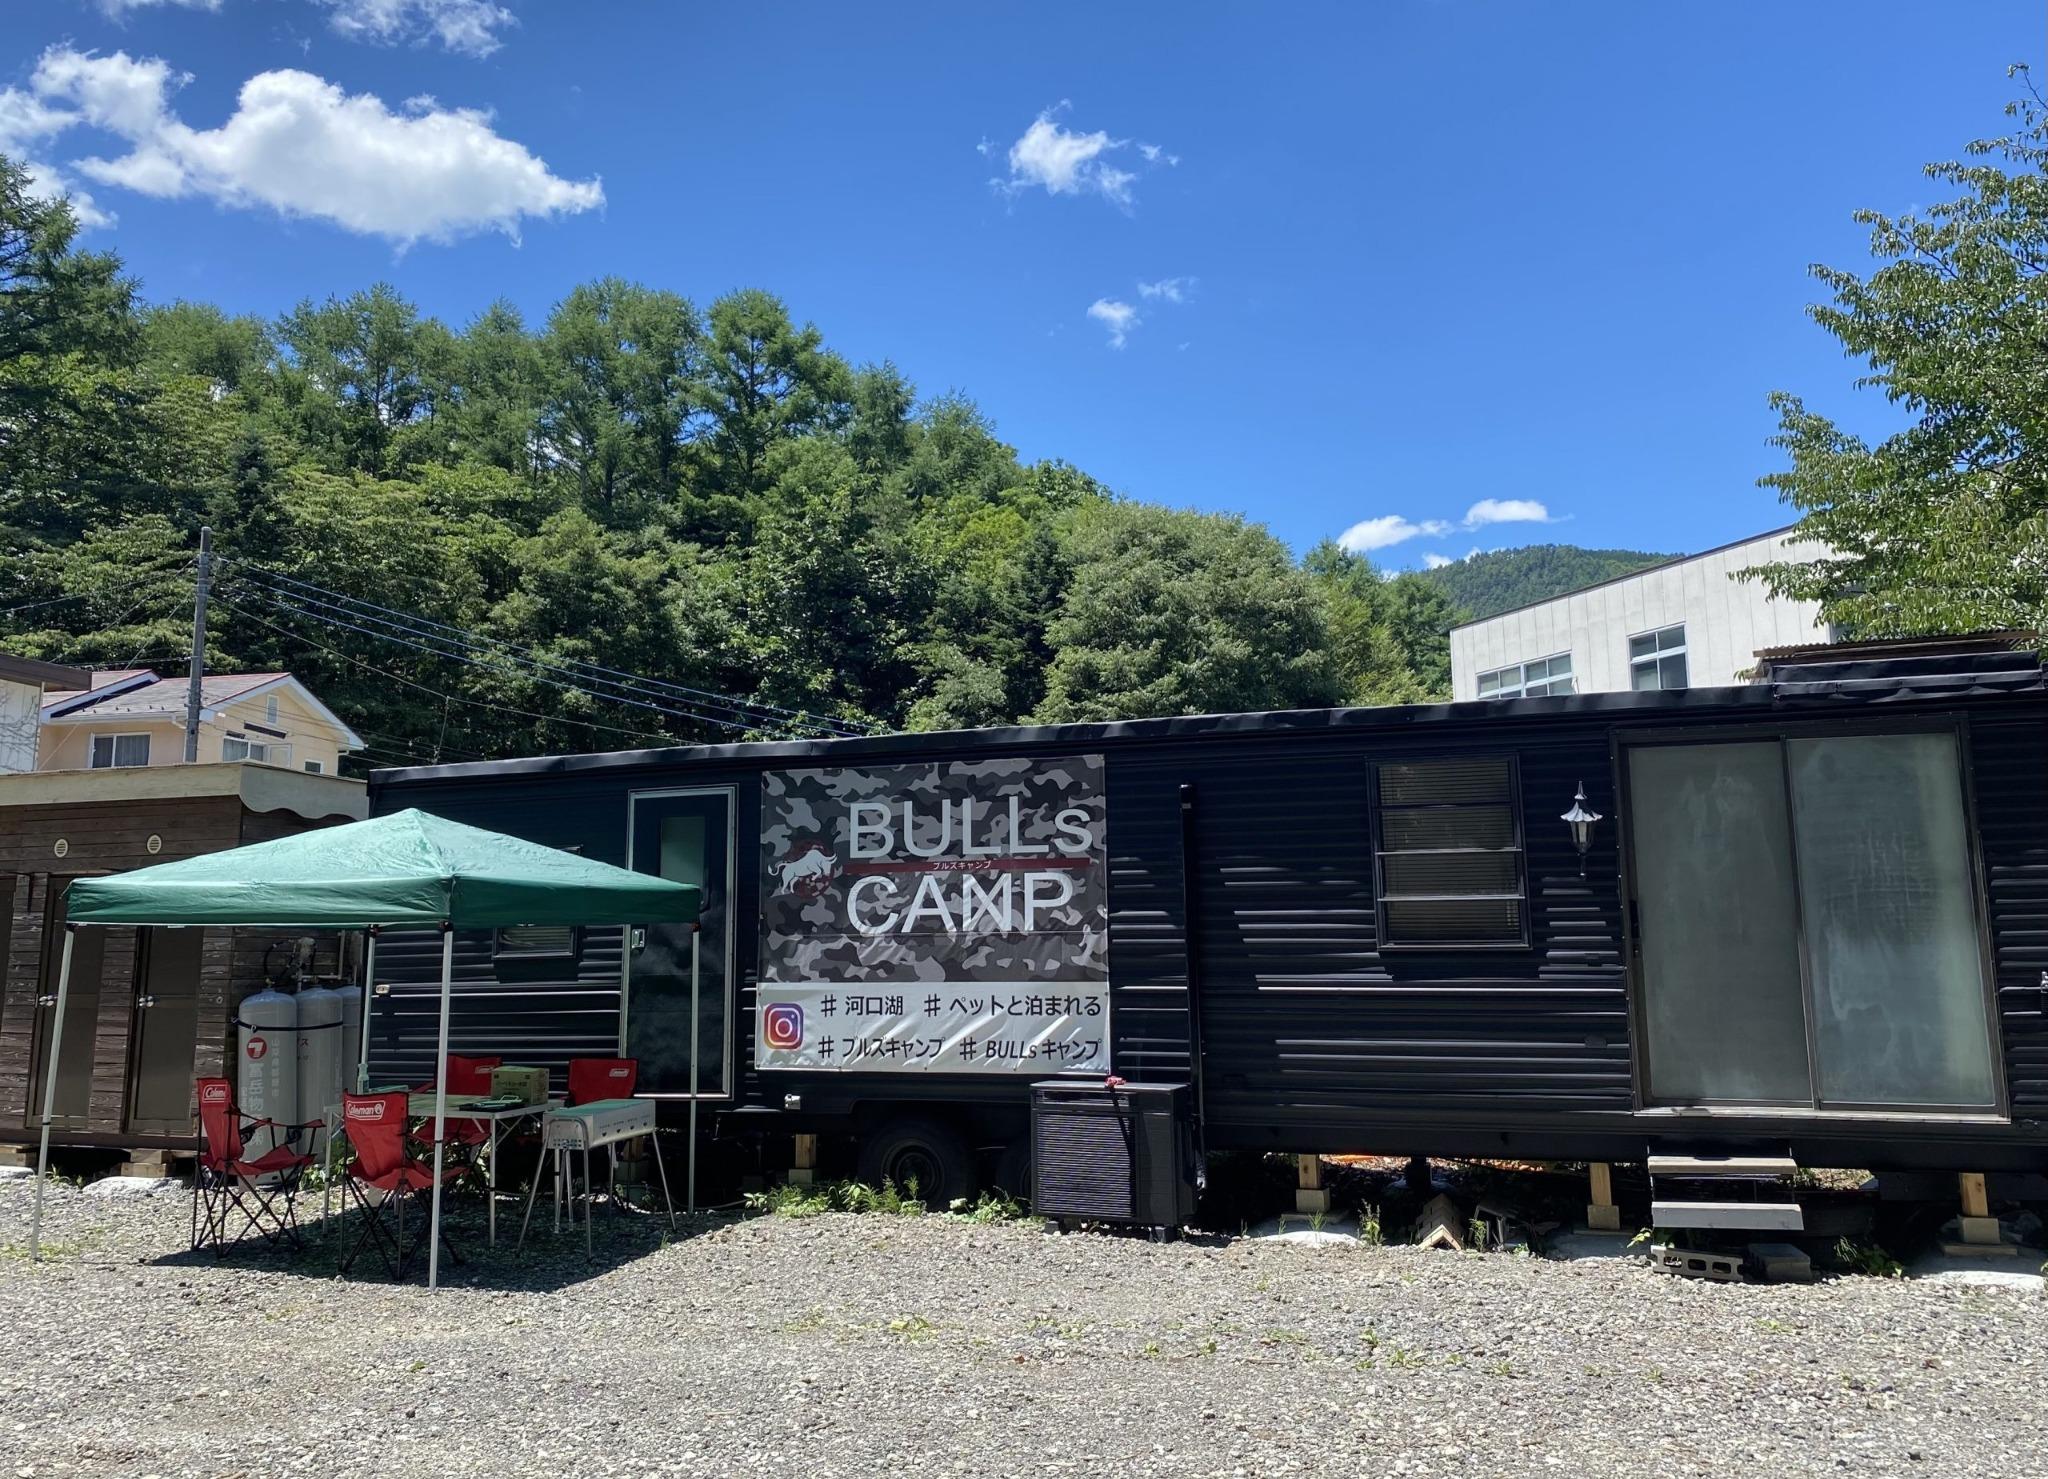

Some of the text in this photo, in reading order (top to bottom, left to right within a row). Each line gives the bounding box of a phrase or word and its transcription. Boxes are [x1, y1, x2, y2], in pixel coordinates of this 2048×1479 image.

[849, 796, 1093, 859] BULLs
[847, 872, 1073, 935] CAMP
[845, 995, 904, 1017] 河口湖
[949, 994, 1101, 1017] ペットと泊まれる
[842, 1036, 946, 1059] ブルズキャンプ
[347, 1102, 374, 1115] Coleman
